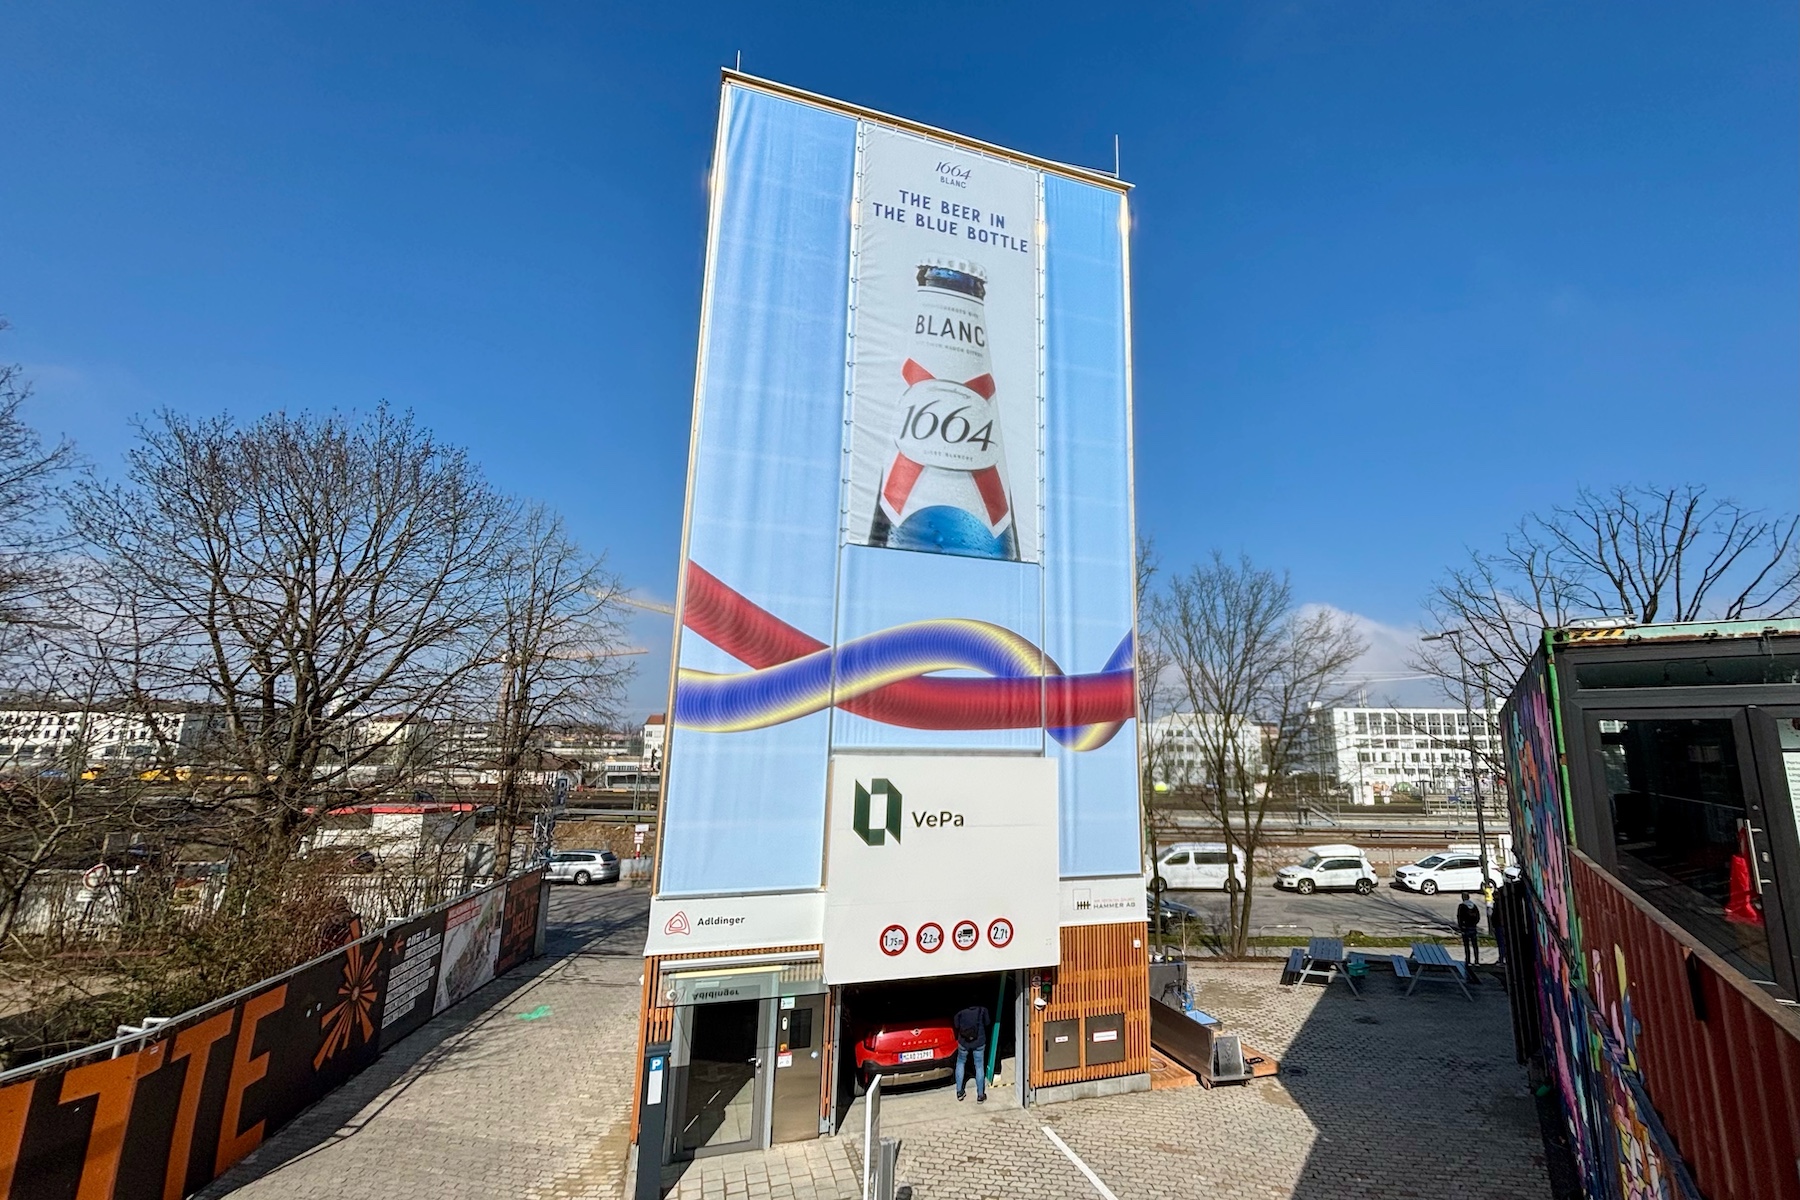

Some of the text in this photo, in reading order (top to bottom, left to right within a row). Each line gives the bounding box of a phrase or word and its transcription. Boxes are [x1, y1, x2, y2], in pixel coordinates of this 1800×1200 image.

[935, 161, 972, 180] 1664
[940, 176, 967, 189] BLANC
[899, 189, 1005, 229] THE BEER IN
[872, 202, 1028, 254] THE BLUE BOTTLE
[915, 314, 985, 348] BLANC
[899, 399, 998, 452] 1664
[911, 810, 964, 828] VePa
[697, 915, 745, 927] Adldinger
